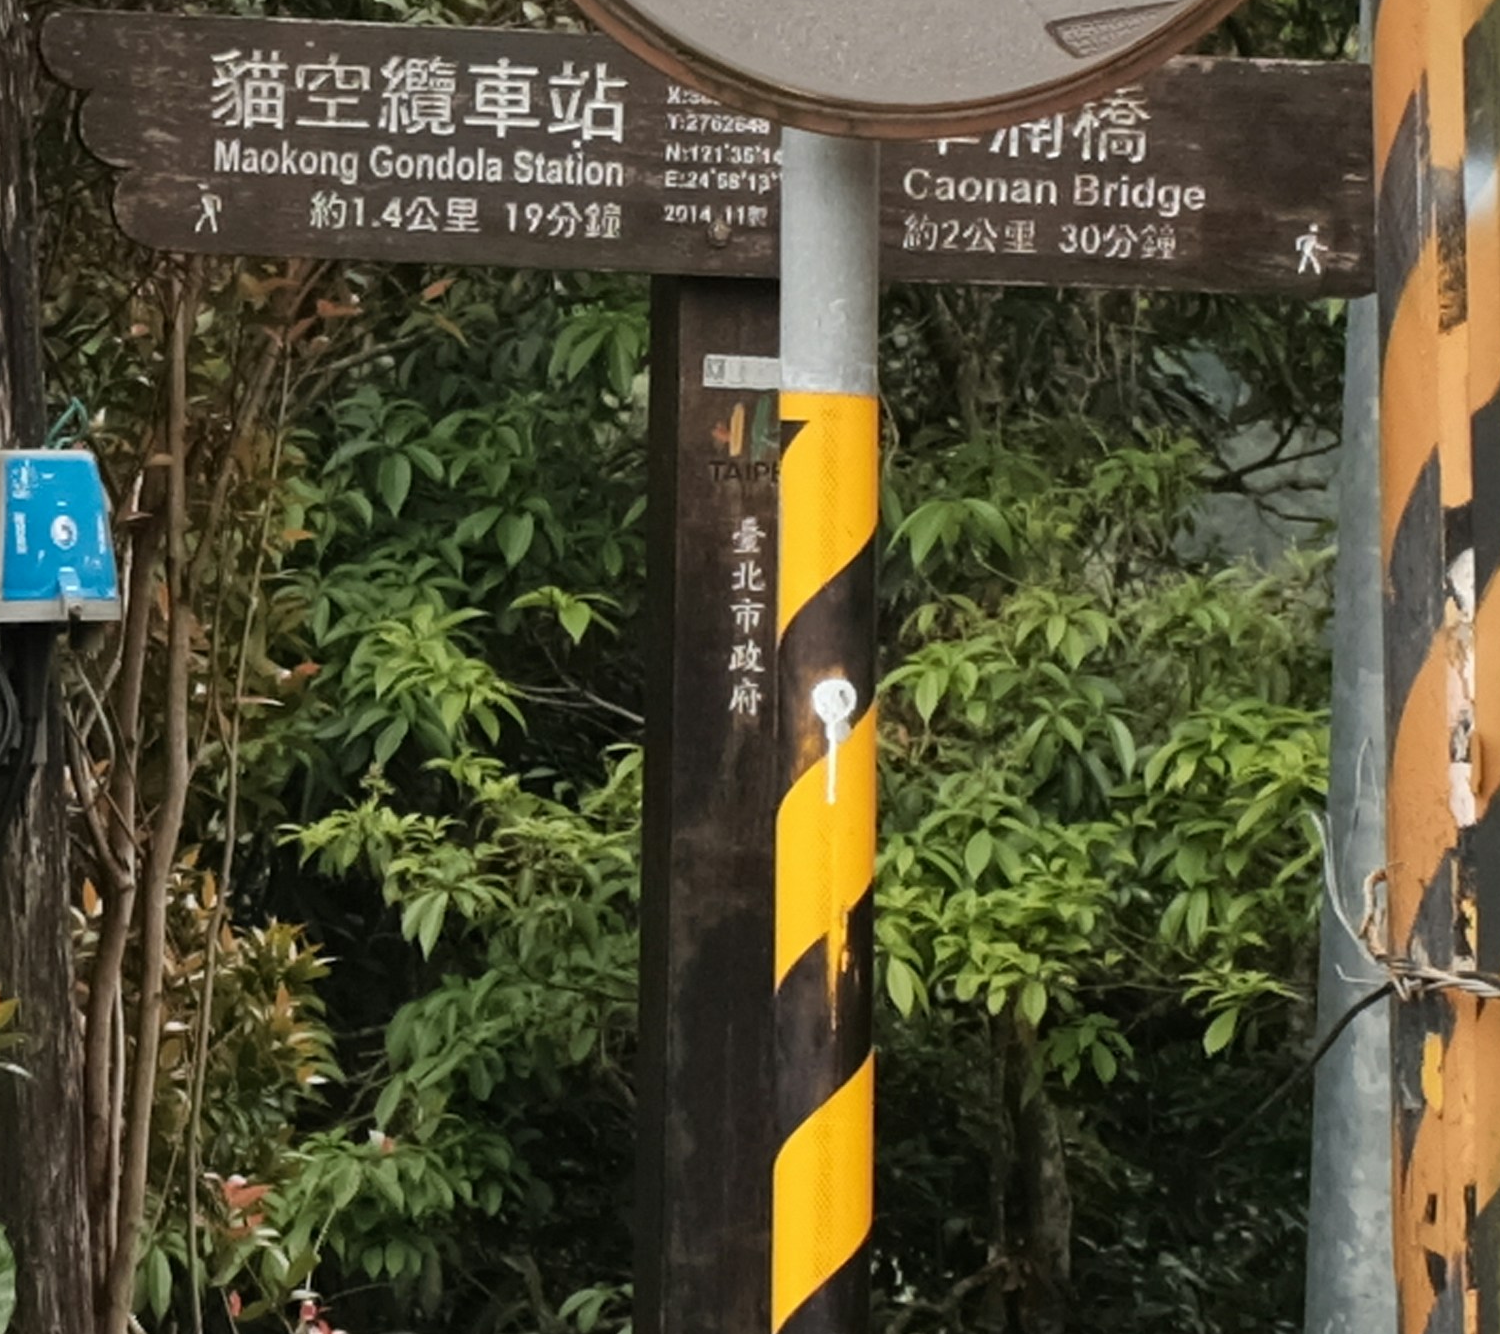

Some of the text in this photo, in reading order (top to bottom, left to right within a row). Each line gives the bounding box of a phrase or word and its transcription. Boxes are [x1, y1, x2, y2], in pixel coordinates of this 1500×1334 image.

[210, 48, 629, 143] 貓空纜車站
[213, 138, 624, 187] Maokong Gondola Station
[309, 190, 622, 239] 約1.4公里 19分鐘
[903, 168, 1206, 217] Caonan Bridge
[902, 213, 1177, 260] 約2公里 30分鐘
[728, 516, 768, 718] 臺北市政府
